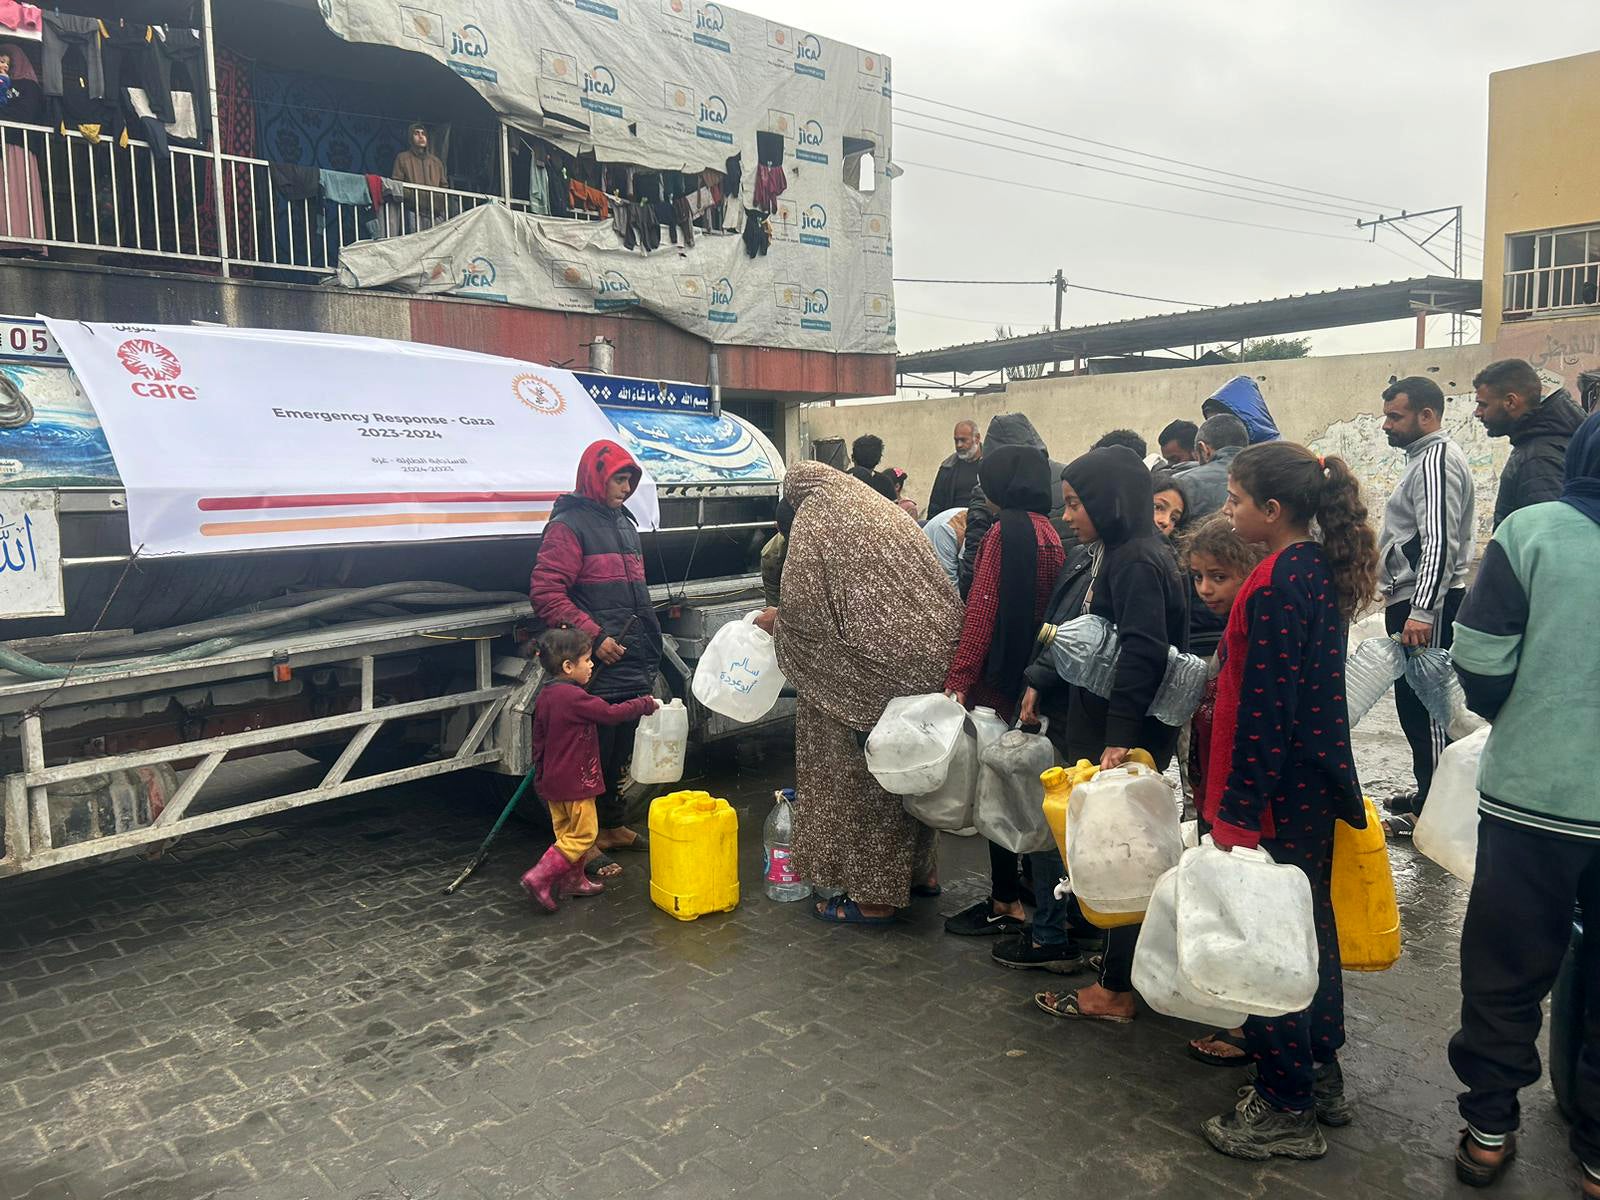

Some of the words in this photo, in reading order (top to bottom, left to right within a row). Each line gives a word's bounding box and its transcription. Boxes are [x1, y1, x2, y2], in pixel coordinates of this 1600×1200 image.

[10, 327, 63, 353] 05
[131, 382, 197, 400] care
[272, 408, 369, 424] Emergency
[373, 413, 447, 427] Response
[459, 416, 495, 426] Gaza
[357, 428, 442, 440] 2023-2024
